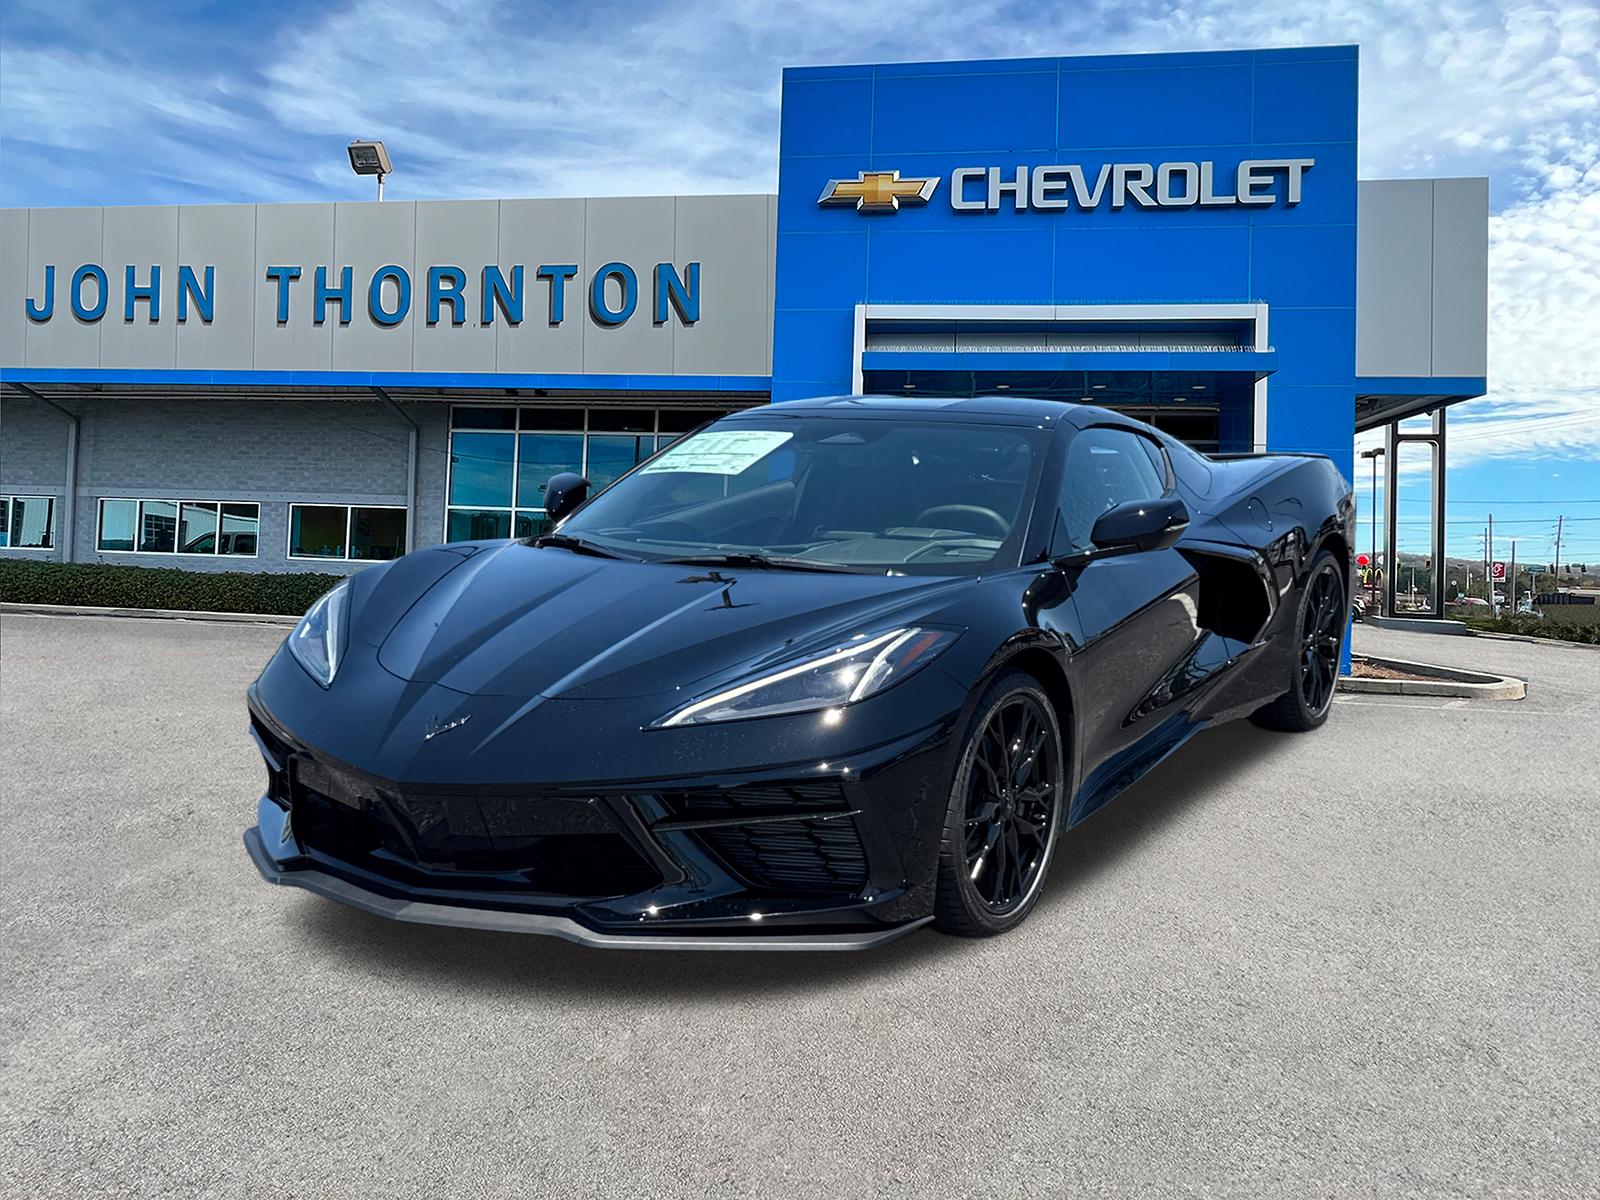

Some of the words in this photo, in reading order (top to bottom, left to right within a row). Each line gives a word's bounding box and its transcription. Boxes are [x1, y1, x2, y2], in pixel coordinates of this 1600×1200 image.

[950, 157, 1316, 212] CHEVROLET
[25, 263, 216, 323] JOHN
[266, 261, 701, 327] THORNTON
